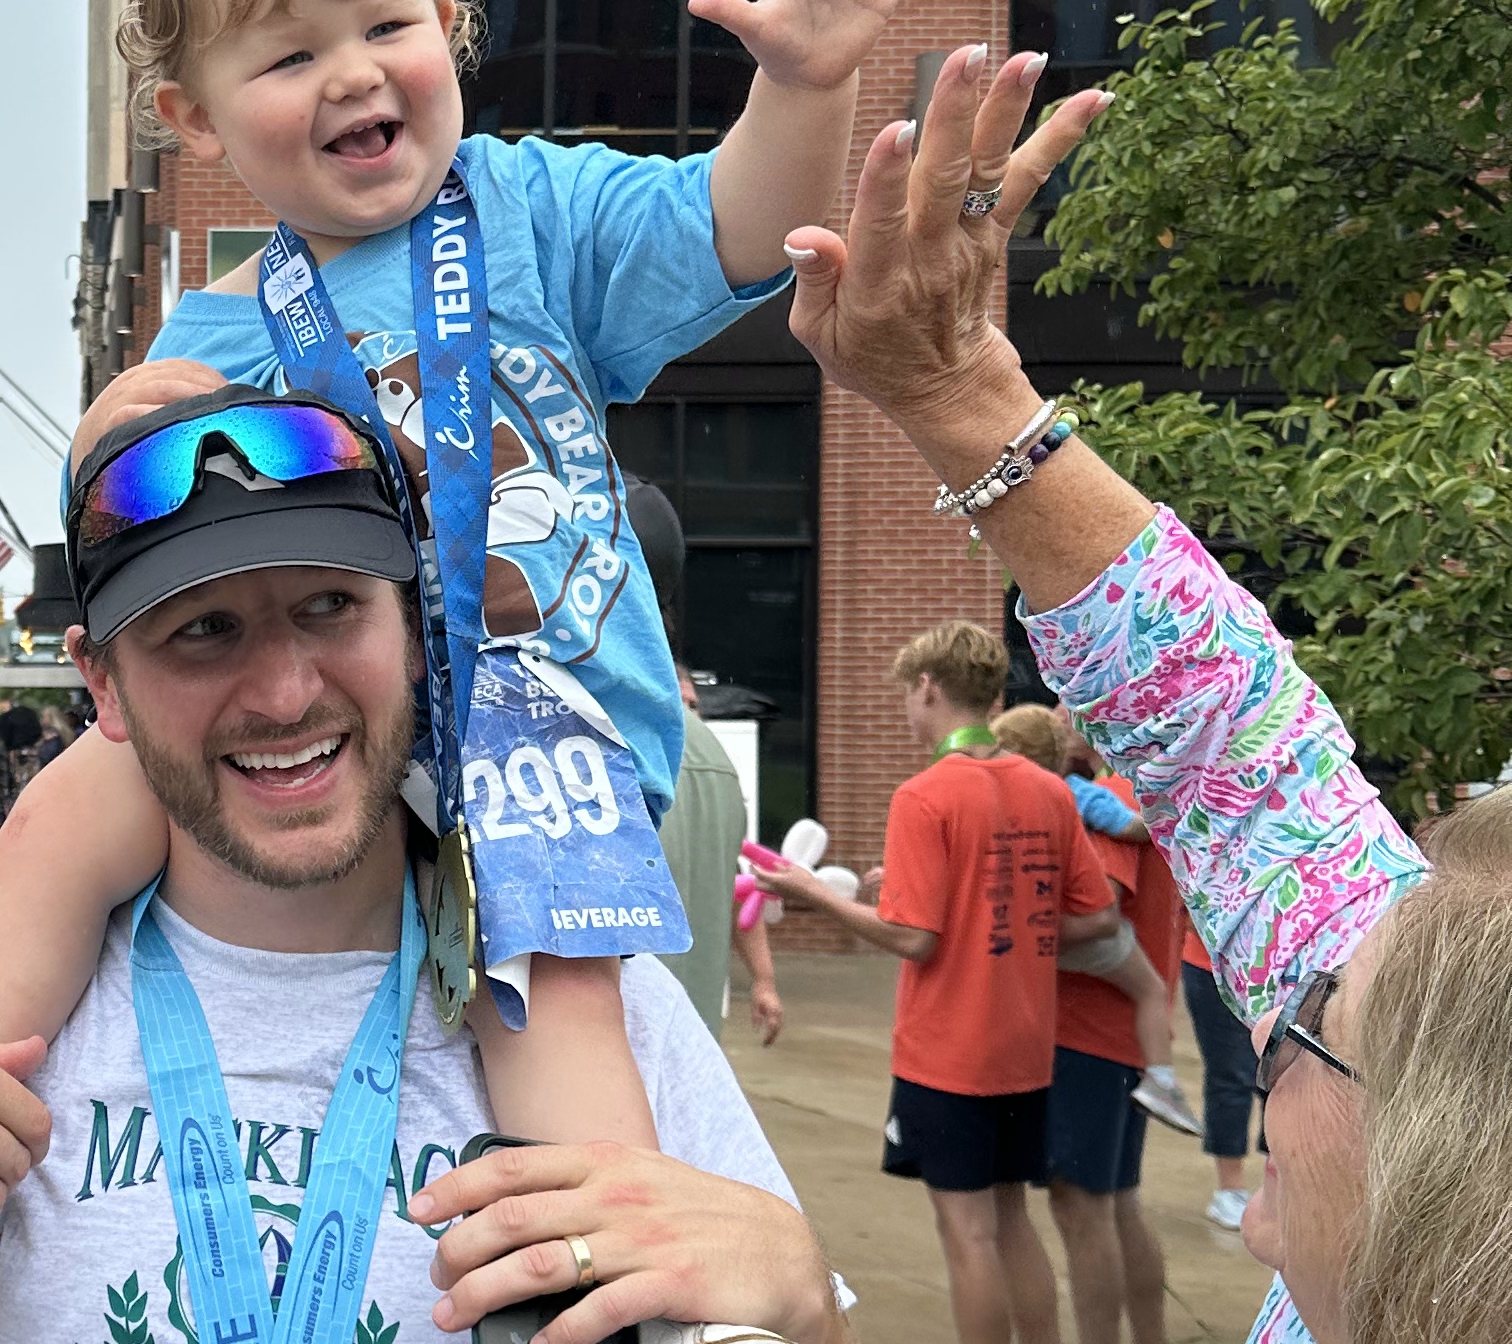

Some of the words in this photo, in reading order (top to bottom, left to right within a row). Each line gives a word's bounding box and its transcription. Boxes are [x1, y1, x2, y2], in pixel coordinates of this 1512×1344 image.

[433, 215, 471, 341] TEDDY
[286, 300, 319, 348] IBEW
[317, 309, 334, 336] LOCAL
[544, 406, 609, 523] BEAR
[462, 736, 621, 844] 299
[187, 1136, 207, 1190] Energy
[216, 1133, 228, 1149] on
[217, 1149, 235, 1185] Count
[199, 1192, 225, 1278] Consumers
[313, 1229, 337, 1285] Energy
[341, 1254, 359, 1291] Count
[352, 1234, 365, 1254] on
